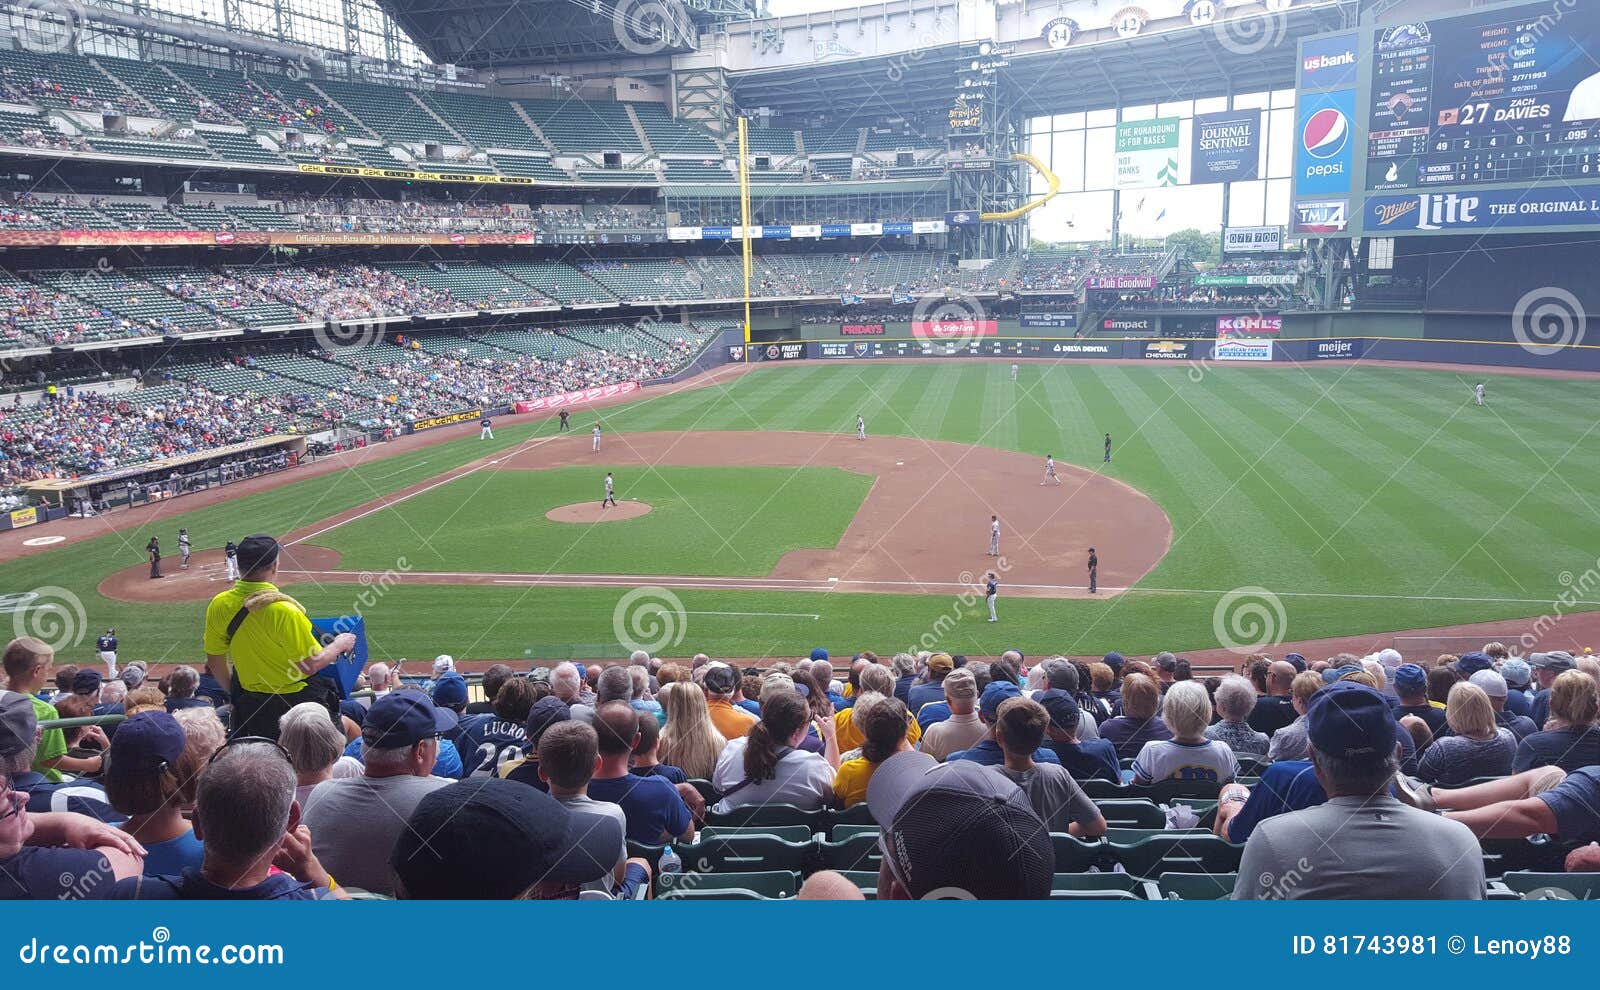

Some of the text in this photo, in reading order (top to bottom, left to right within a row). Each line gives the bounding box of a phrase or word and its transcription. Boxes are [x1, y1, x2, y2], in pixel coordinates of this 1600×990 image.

[1194, 6, 1211, 18] 44
[1120, 18, 1137, 31] 42
[1053, 29, 1067, 43] 34
[1514, 60, 1536, 69] RIGHT
[1512, 71, 1547, 82] 2/7/1993
[1454, 80, 1471, 88] DATE
[1510, 98, 1536, 107] ZACH
[1460, 103, 1490, 125] 27
[1494, 104, 1550, 121] DAVIES
[1120, 123, 1176, 137] THE RUNAROUND
[1201, 125, 1252, 140] JOURNAL
[1120, 135, 1166, 147] IS FOR BASES
[1199, 139, 1252, 151] SENTINEL
[1436, 142, 1448, 151] 49
[1463, 140, 1470, 149] 2
[1490, 137, 1496, 146] 4
[1516, 135, 1523, 144] 0
[1564, 129, 1588, 141] .095
[1119, 157, 1131, 165] NOT
[302, 165, 323, 173] GEHL
[1119, 166, 1140, 175] BANKS
[1306, 161, 1343, 178] pepsi
[1427, 164, 1451, 173] ROCKIES
[479, 175, 498, 183] GEHL
[1426, 174, 1454, 182] BREWERS
[1375, 200, 1418, 225] Miller
[1416, 194, 1479, 230] Lite
[1489, 204, 1516, 215] THE
[1520, 200, 1587, 213] ORIGINAL
[623, 234, 641, 243] 1:59
[1100, 277, 1152, 289] Club Goodwill
[842, 325, 883, 334] FRIDAYS
[1112, 319, 1148, 330] impact
[1220, 319, 1281, 329] KOHL'S
[781, 344, 802, 353] FREAKY
[1319, 342, 1352, 353] meijer
[103, 640, 108, 648] 5
[484, 721, 527, 740] LUCRO
[470, 742, 524, 778] 20
